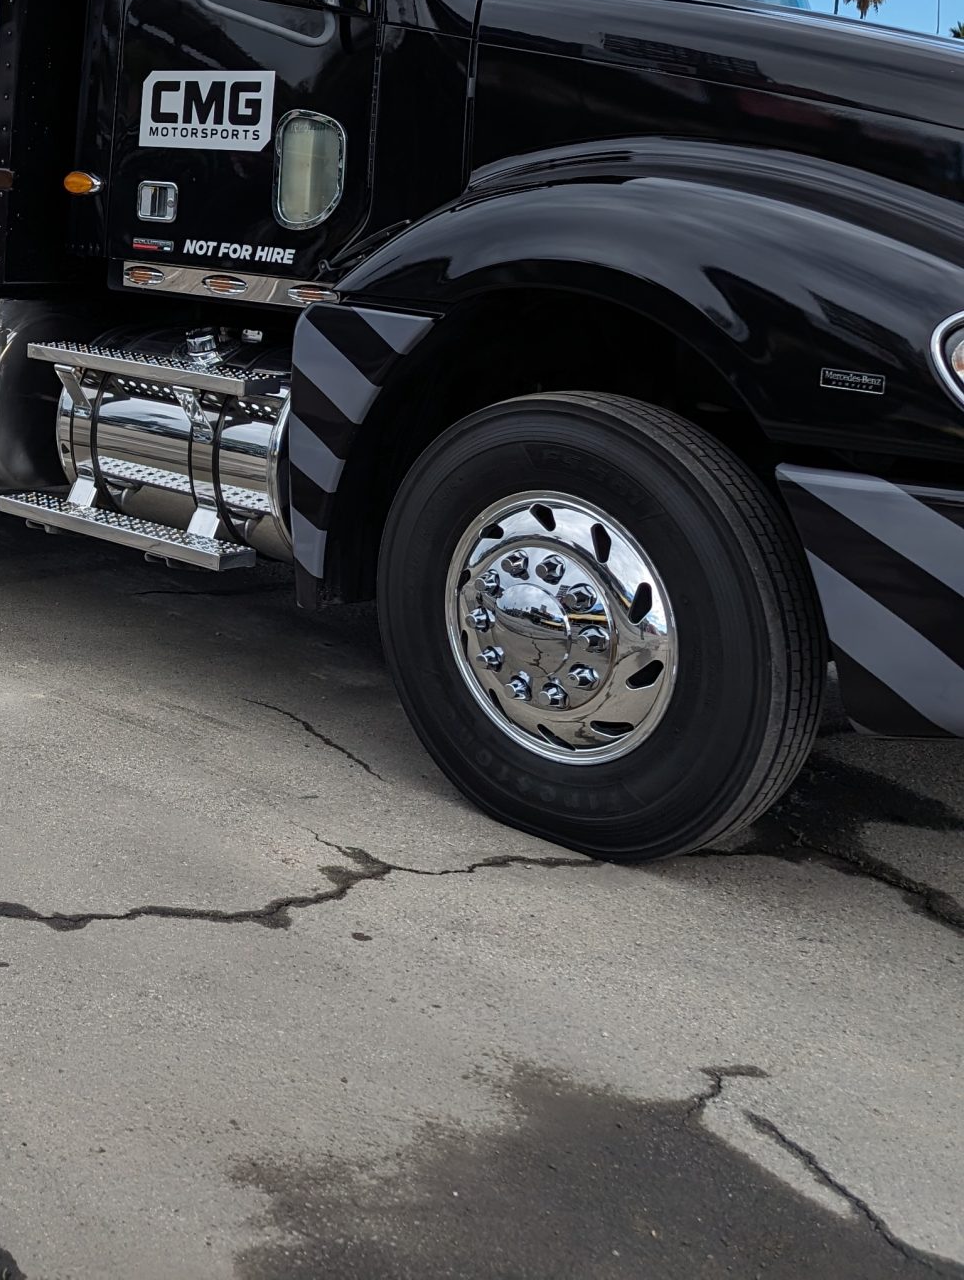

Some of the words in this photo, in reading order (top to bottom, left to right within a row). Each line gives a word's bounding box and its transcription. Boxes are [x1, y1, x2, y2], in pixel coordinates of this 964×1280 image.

[150, 81, 262, 126] CMG
[149, 127, 260, 141] MOTORSPORTS
[183, 239, 217, 256] NOT
[218, 242, 253, 260] FOR
[255, 247, 296, 265] HIRE
